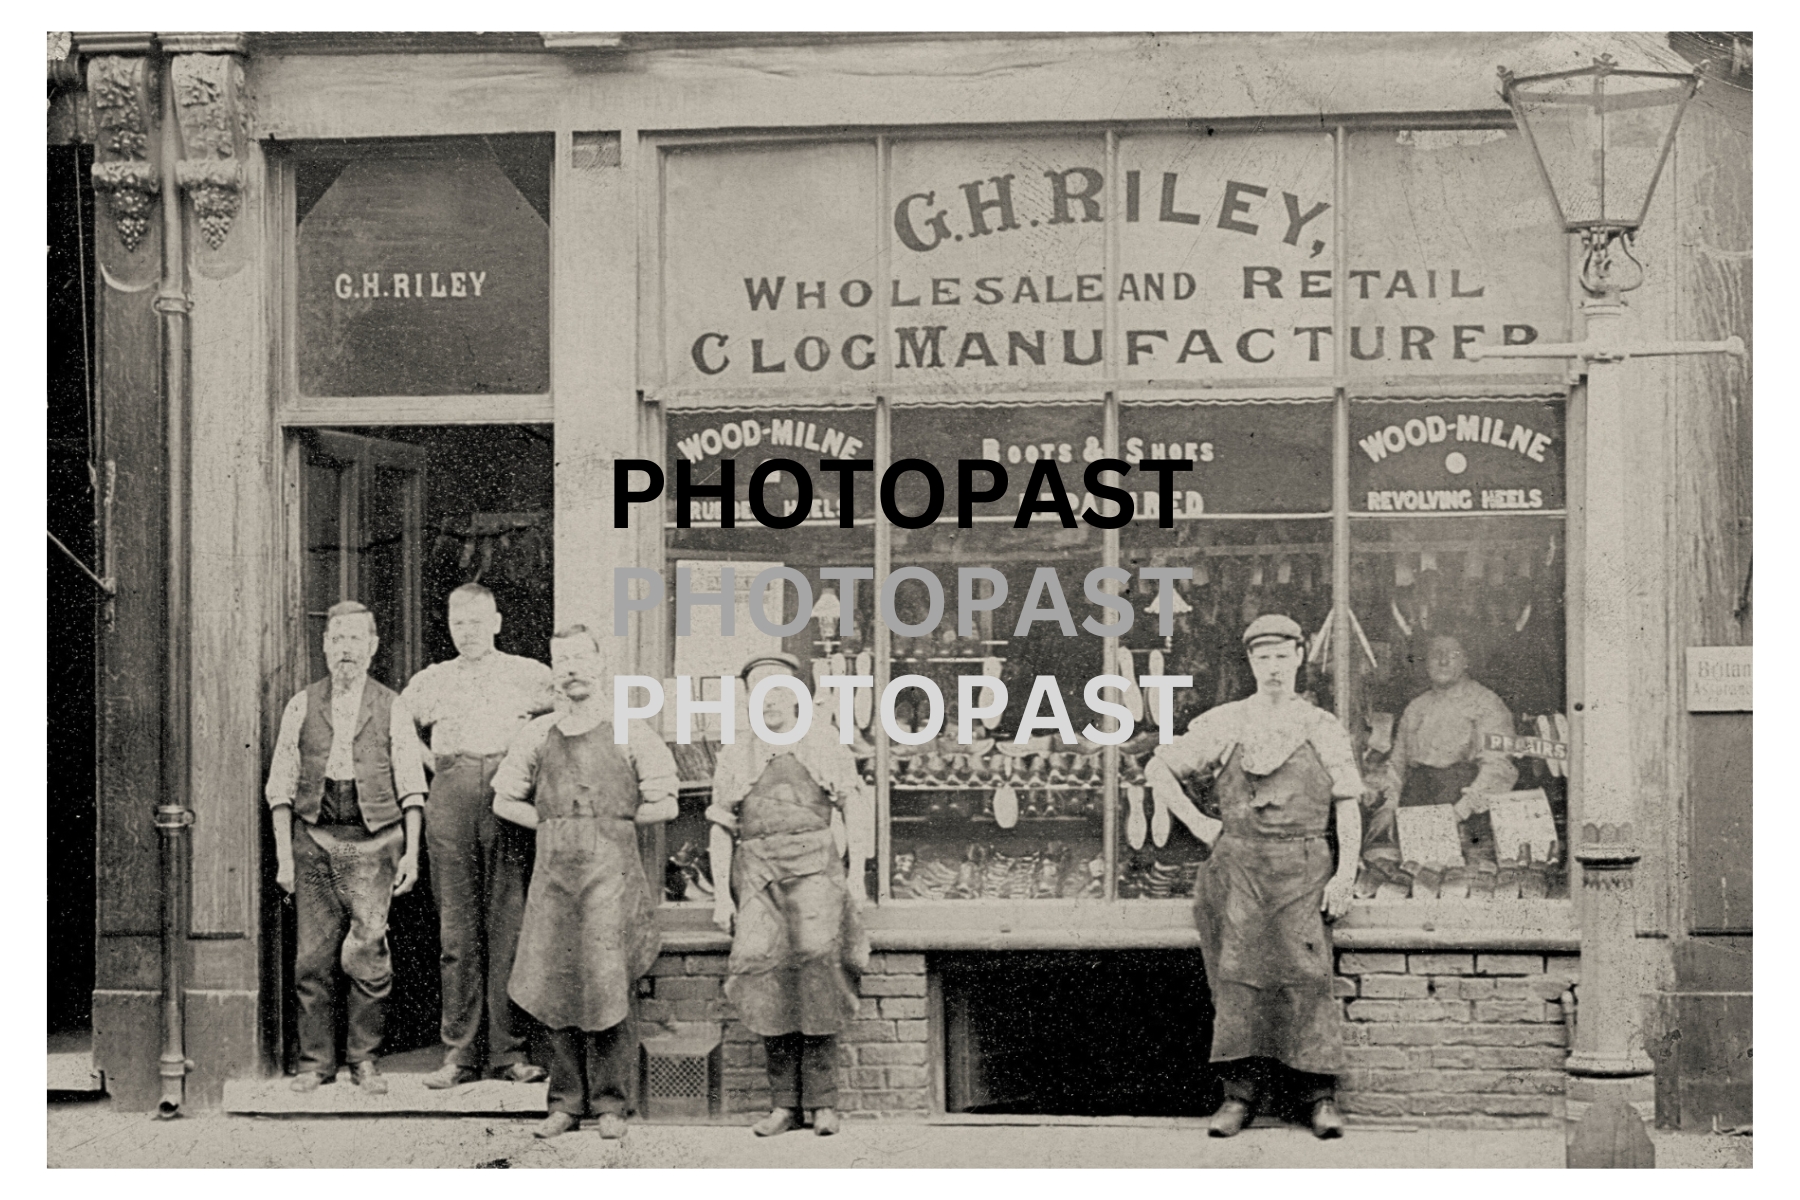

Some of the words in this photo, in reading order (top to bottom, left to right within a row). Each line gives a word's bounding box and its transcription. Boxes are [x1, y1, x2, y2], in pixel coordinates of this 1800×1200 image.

[335, 271, 486, 299] G.H.RILEY
[743, 274, 1104, 311] WHOLESALE
[1118, 272, 1197, 301] AND
[1243, 266, 1485, 299] RETAIL
[691, 332, 876, 375] CLOG
[677, 419, 863, 464] WOOD-MILNE
[1126, 437, 1214, 463] SHOES
[1358, 414, 1551, 462] WOOD-MILNE
[1368, 490, 1472, 510] REVOLVING
[1482, 489, 1542, 509] HEELS
